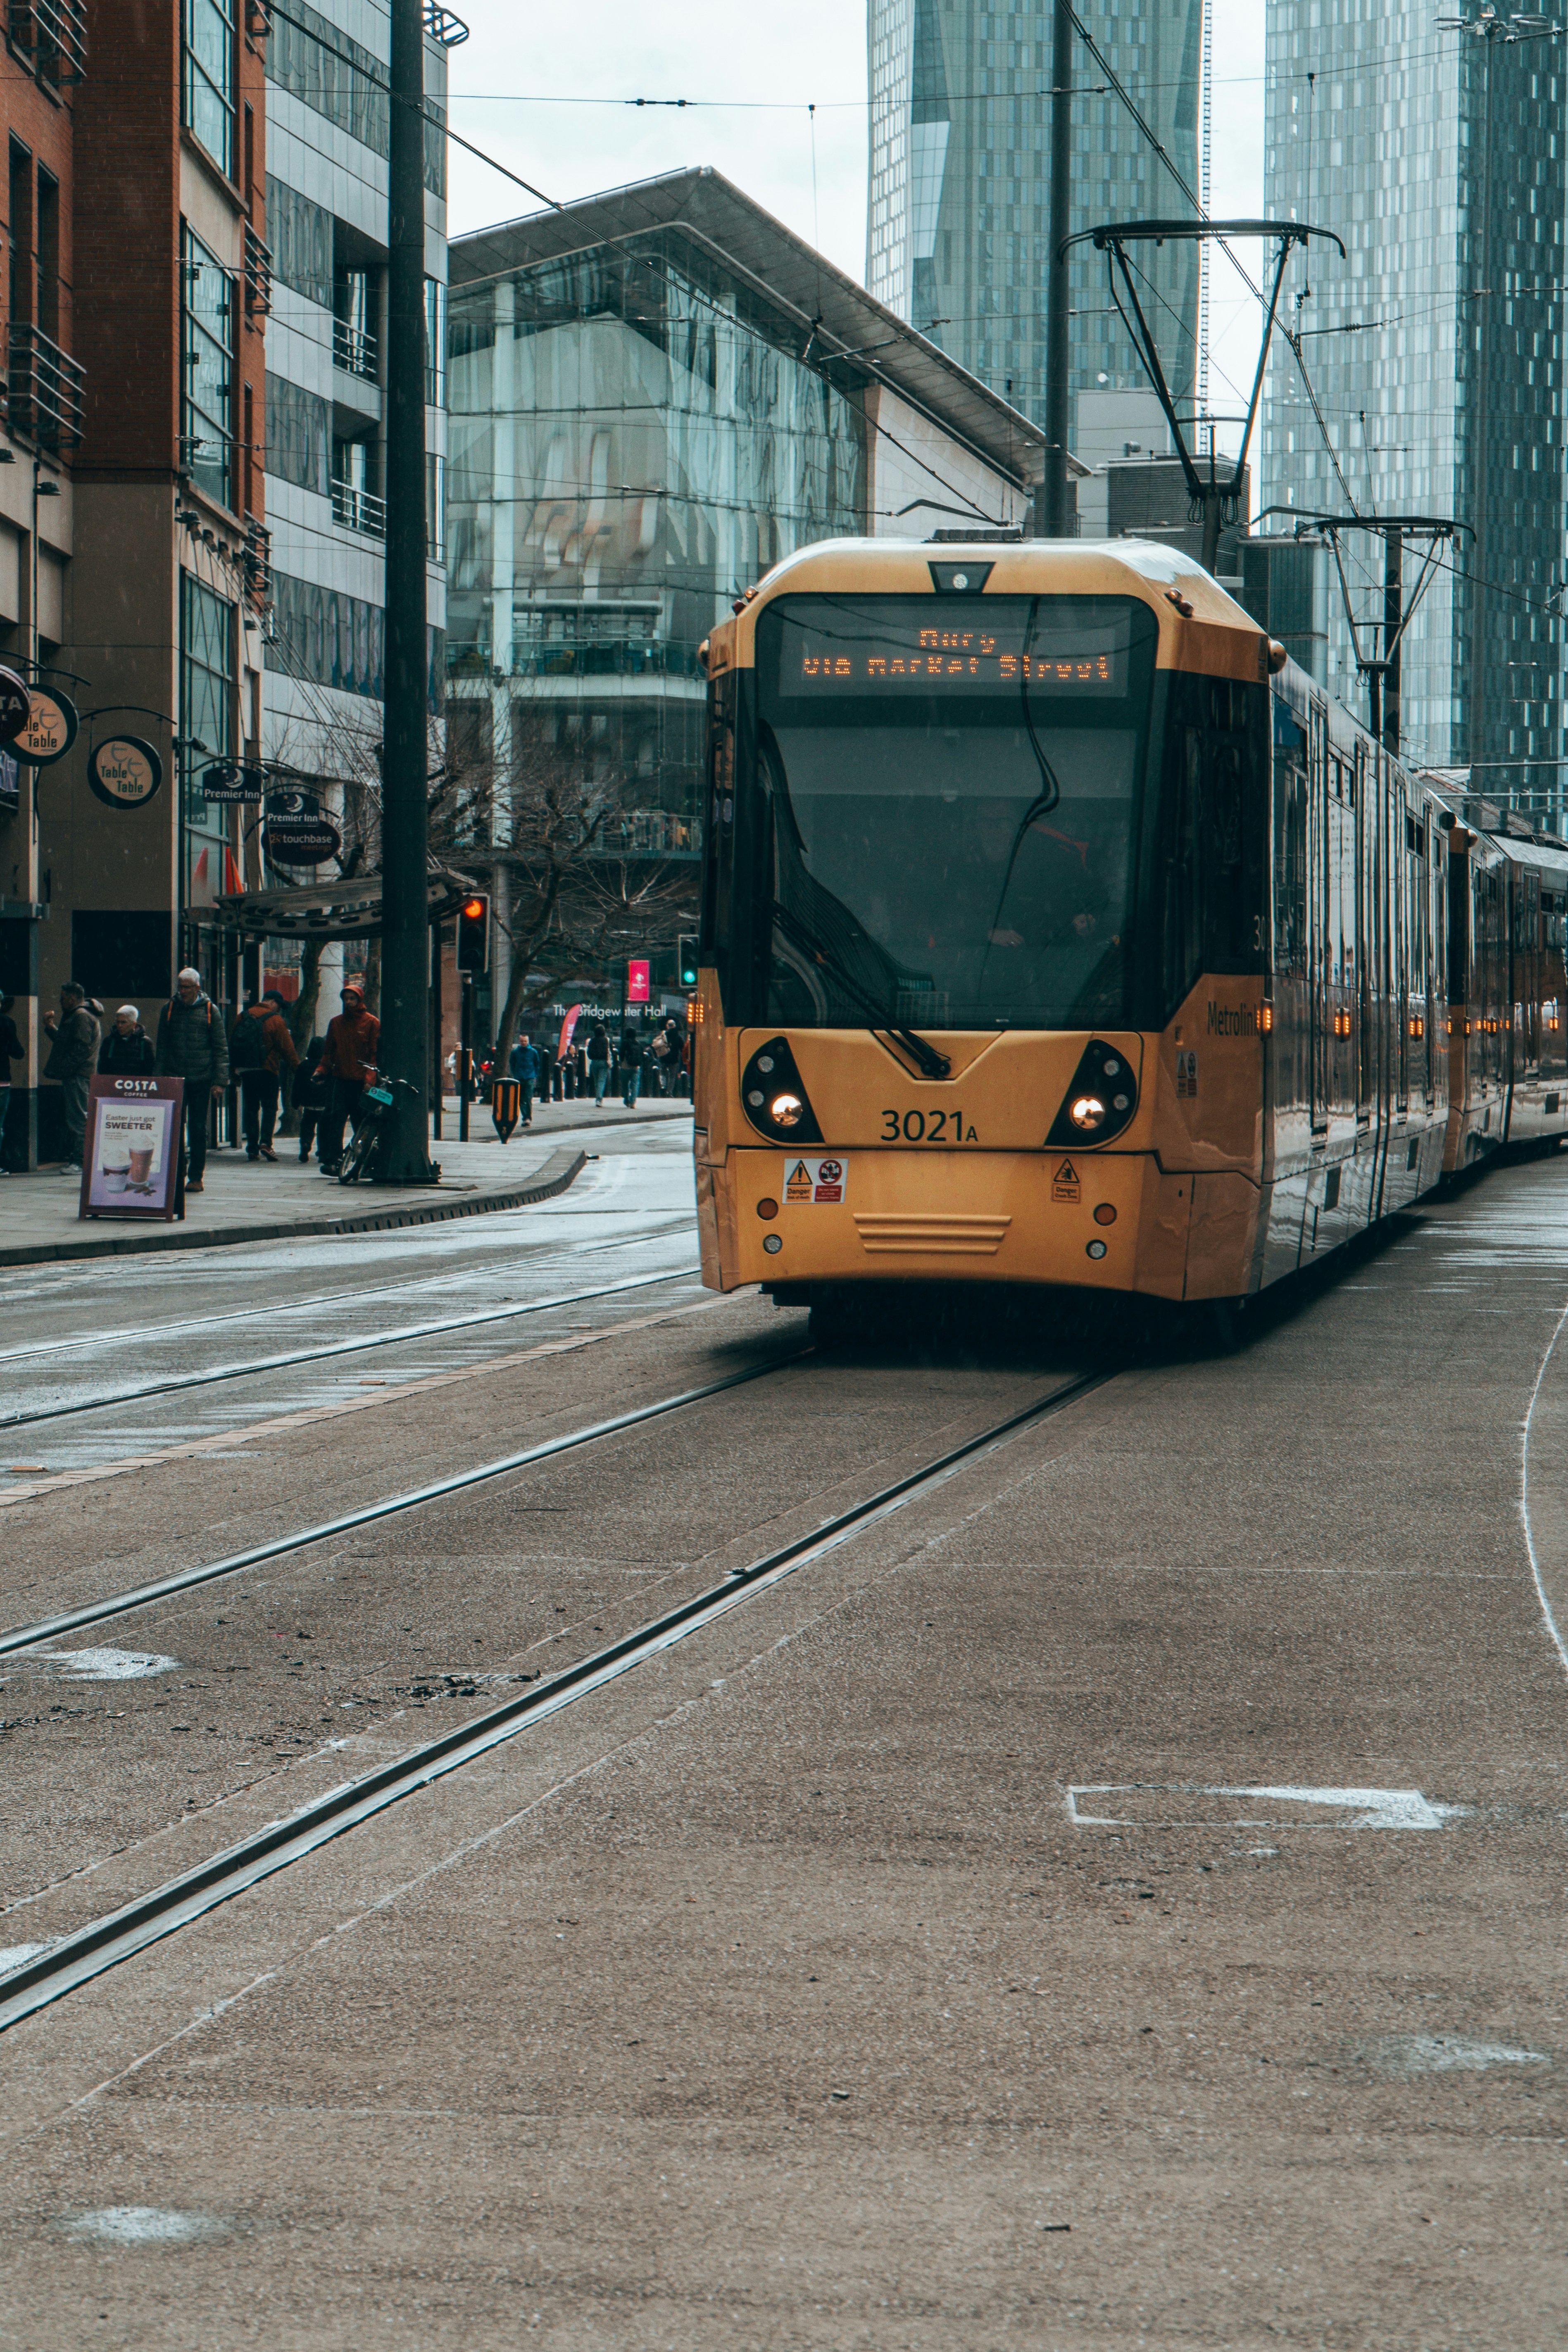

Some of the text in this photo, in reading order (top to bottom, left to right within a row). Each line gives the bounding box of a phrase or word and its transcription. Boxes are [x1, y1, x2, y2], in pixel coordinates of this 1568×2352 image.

[27, 730, 57, 748] Table
[101, 763, 127, 778] Table
[117, 778, 143, 793] Table
[204, 789, 260, 799] Premier Inn
[268, 813, 318, 822] Premier Inn
[283, 834, 332, 843] touchbase
[554, 1004, 667, 1020] Th Bridgewter Hall
[1206, 1001, 1260, 1036] Metrolink
[115, 1080, 158, 1091] COSTA
[105, 1122, 152, 1130] SWEETER
